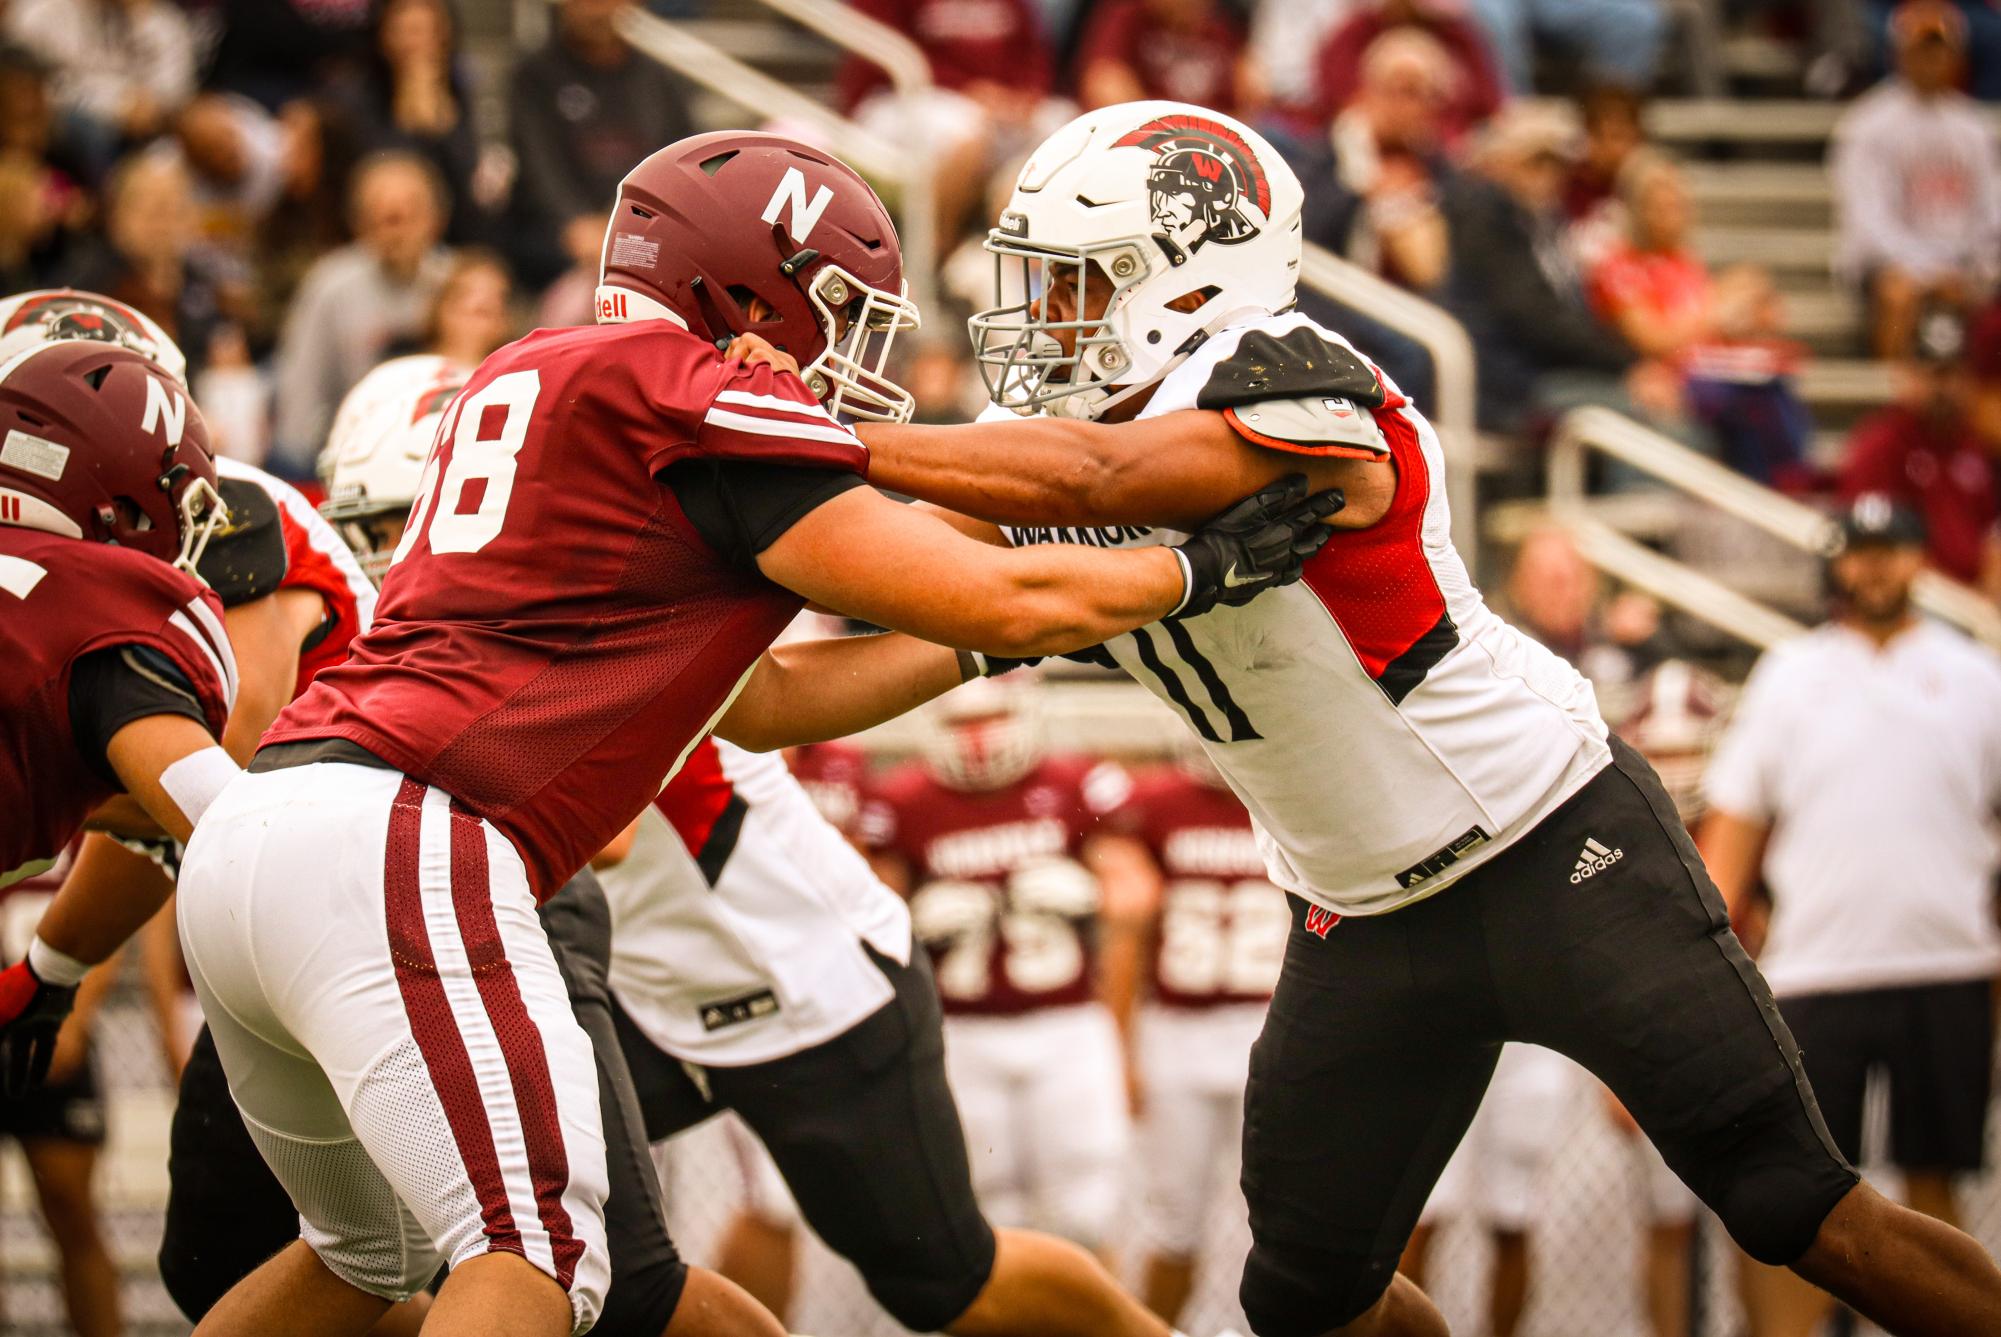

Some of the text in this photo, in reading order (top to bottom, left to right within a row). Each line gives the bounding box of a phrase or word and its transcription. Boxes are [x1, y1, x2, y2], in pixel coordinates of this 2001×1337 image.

[1191, 152, 1223, 183] W
[760, 166, 835, 245] N
[141, 374, 186, 451] N
[1569, 848, 1624, 885] adidas
